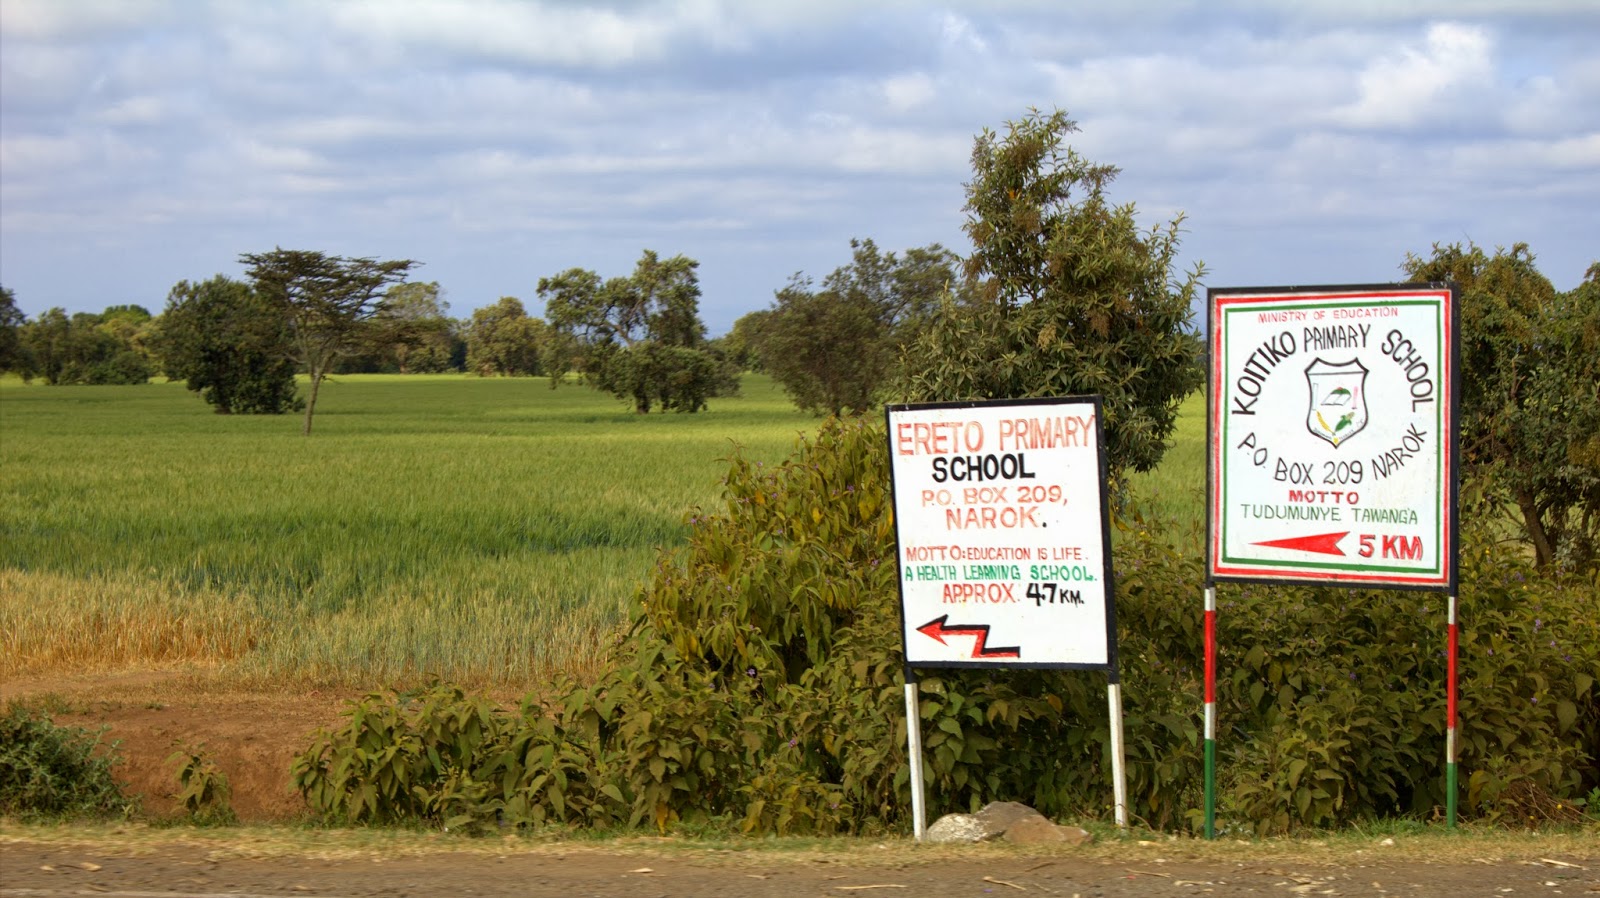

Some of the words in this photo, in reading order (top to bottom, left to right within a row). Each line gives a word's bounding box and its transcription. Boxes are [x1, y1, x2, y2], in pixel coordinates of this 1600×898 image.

[1258, 311, 1307, 324] MINISTRY
[1313, 310, 1326, 320] OF
[1333, 306, 1399, 319] EDUCATION
[1231, 331, 1296, 416] KOITIKO
[1304, 323, 1371, 352] PRIMARY
[1381, 329, 1434, 412] SCHOOL
[897, 421, 984, 456] ERETO
[999, 414, 1095, 451] PRIMARY
[1273, 457, 1314, 485] BOX
[1323, 460, 1363, 484] 209
[1371, 423, 1427, 481] NAROK
[932, 453, 1036, 483] SCHOOL
[963, 487, 1008, 505] BOX
[1017, 485, 1068, 506] 209,
[1289, 490, 1359, 505] MOTTO
[946, 506, 1047, 530] NAROK.
[1240, 504, 1341, 521] TUDUMUNYE
[1037, 548, 1048, 560] IS
[1358, 534, 1376, 558] 5
[1382, 535, 1424, 561] KM
[905, 566, 913, 581] A
[917, 565, 957, 581] HEALTH
[963, 565, 1021, 580] LEARNING
[1030, 565, 1098, 581] SCHOOL.
[943, 583, 1020, 603] APPROX.
